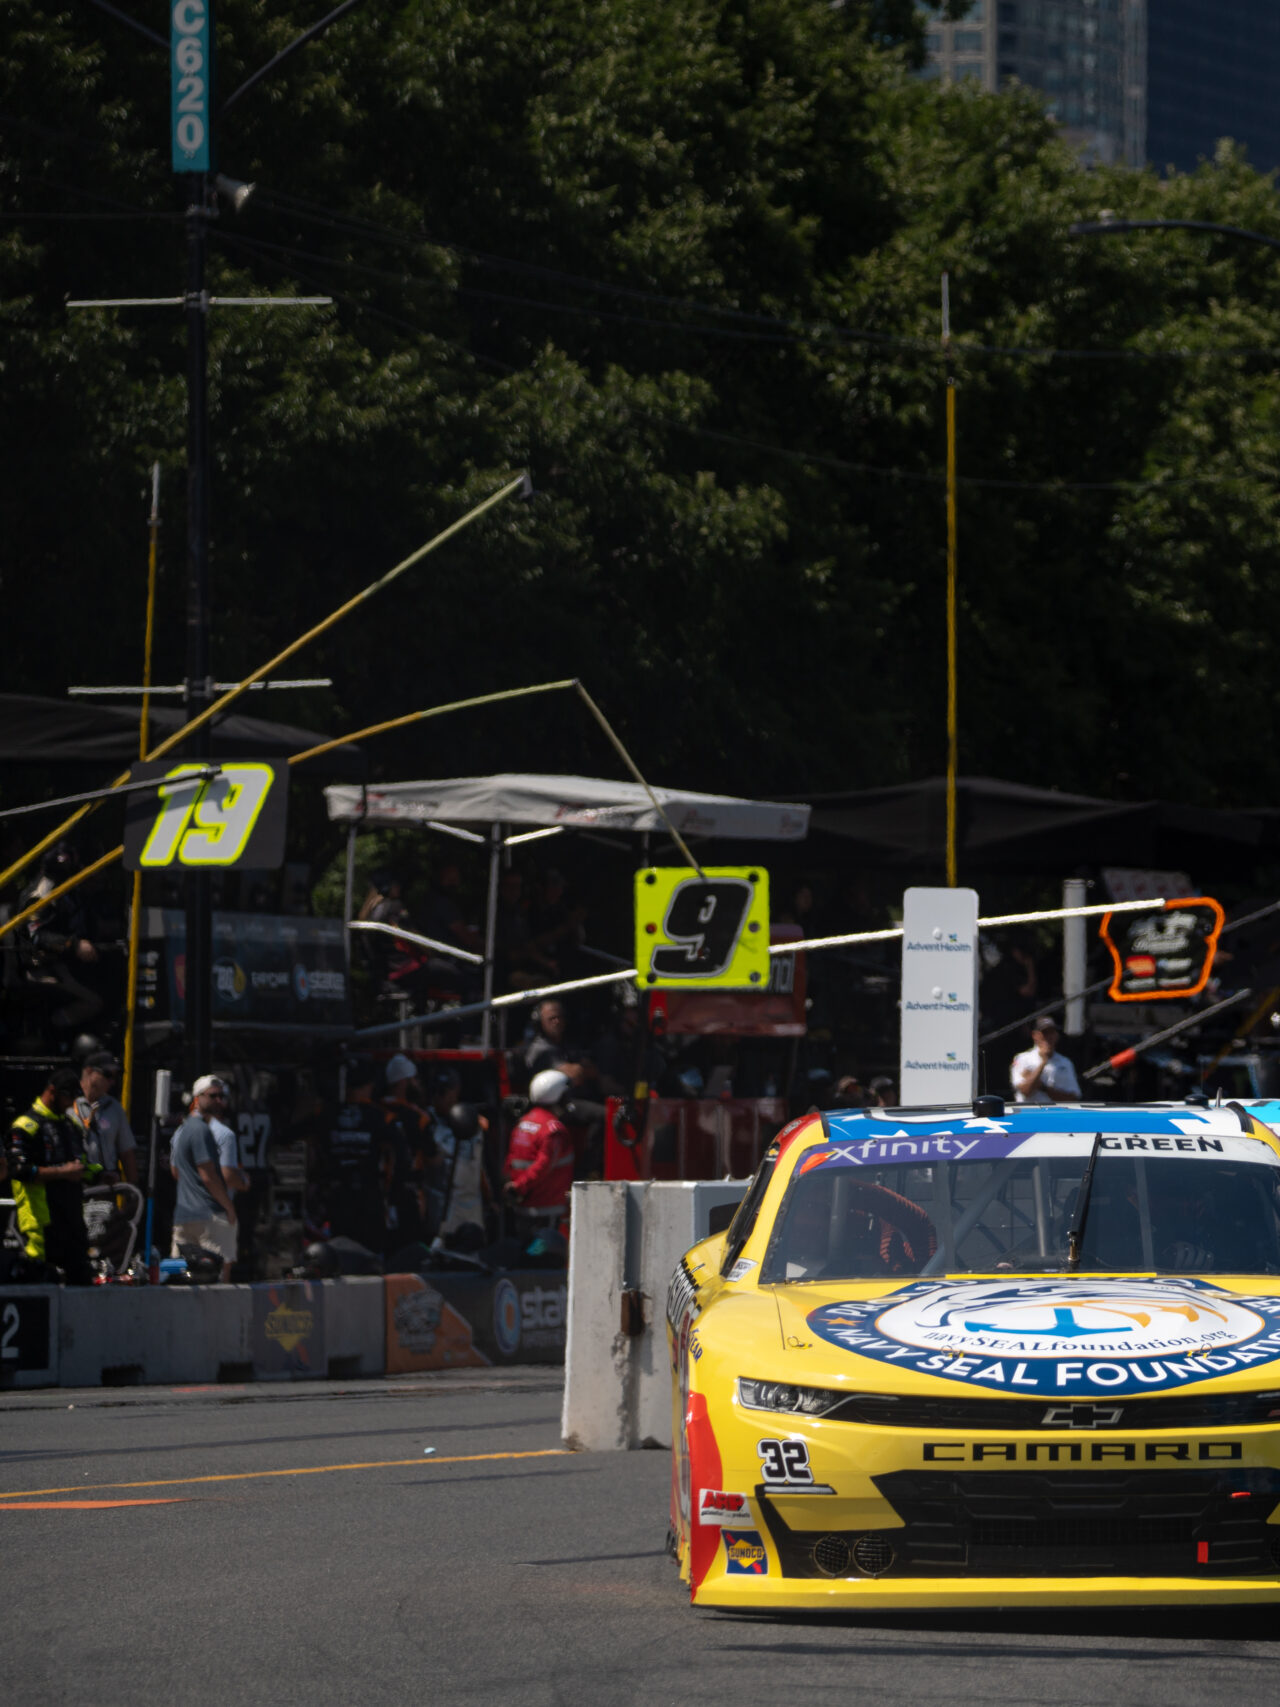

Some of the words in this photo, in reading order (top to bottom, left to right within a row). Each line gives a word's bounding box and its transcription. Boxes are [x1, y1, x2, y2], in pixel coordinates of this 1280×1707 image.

[173, 0, 206, 150] C620
[140, 762, 275, 866] 19
[650, 877, 754, 979] 9
[907, 941, 971, 952] AdventHealth
[906, 1001, 970, 1012] AdventHealth
[905, 1060, 969, 1072] AdventHealth
[238, 1113, 271, 1168] 27
[830, 1138, 979, 1165] xfinity
[1101, 1137, 1224, 1152] GREEN
[826, 1328, 927, 1359] NAVY
[917, 1353, 1039, 1385] SEAL
[757, 1438, 814, 1484] 32
[923, 1442, 1242, 1461] CAMARO
[702, 1491, 744, 1511] ARP
[729, 1547, 763, 1559] SUNOCO
